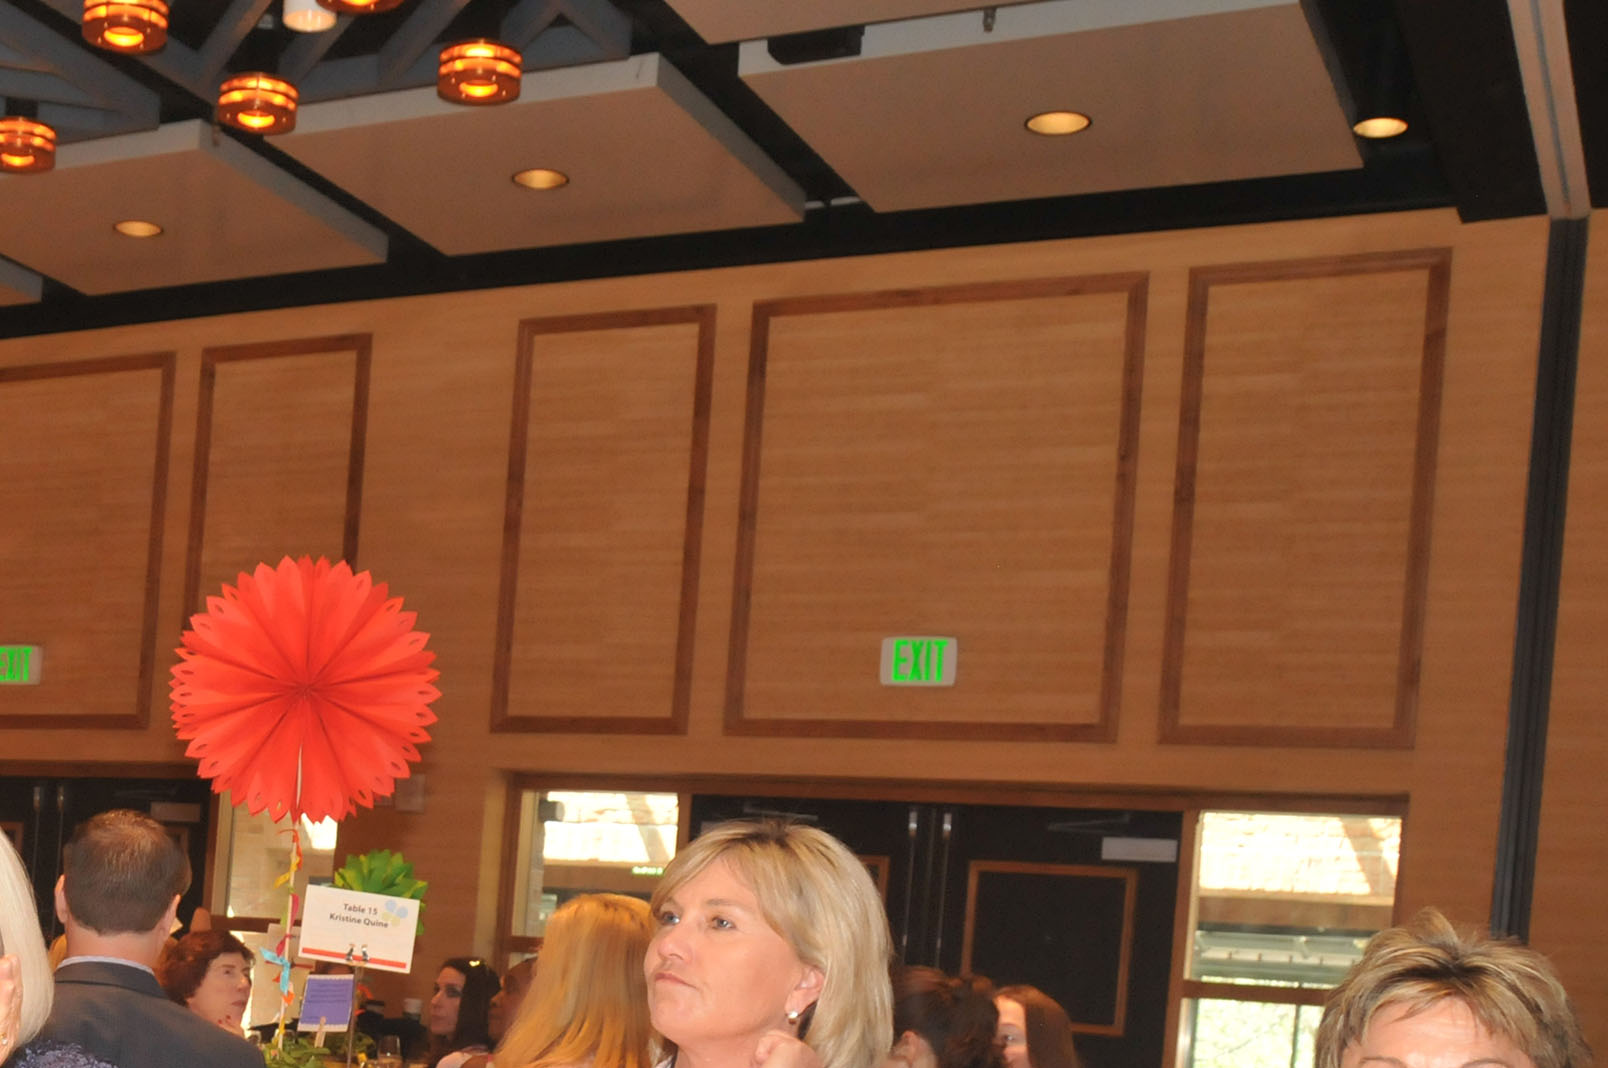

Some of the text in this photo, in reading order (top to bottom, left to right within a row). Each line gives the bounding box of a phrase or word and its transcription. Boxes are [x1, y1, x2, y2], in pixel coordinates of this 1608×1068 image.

[893, 639, 949, 683] EXIT
[344, 903, 378, 915] Table 15
[329, 912, 362, 924] Kristine
